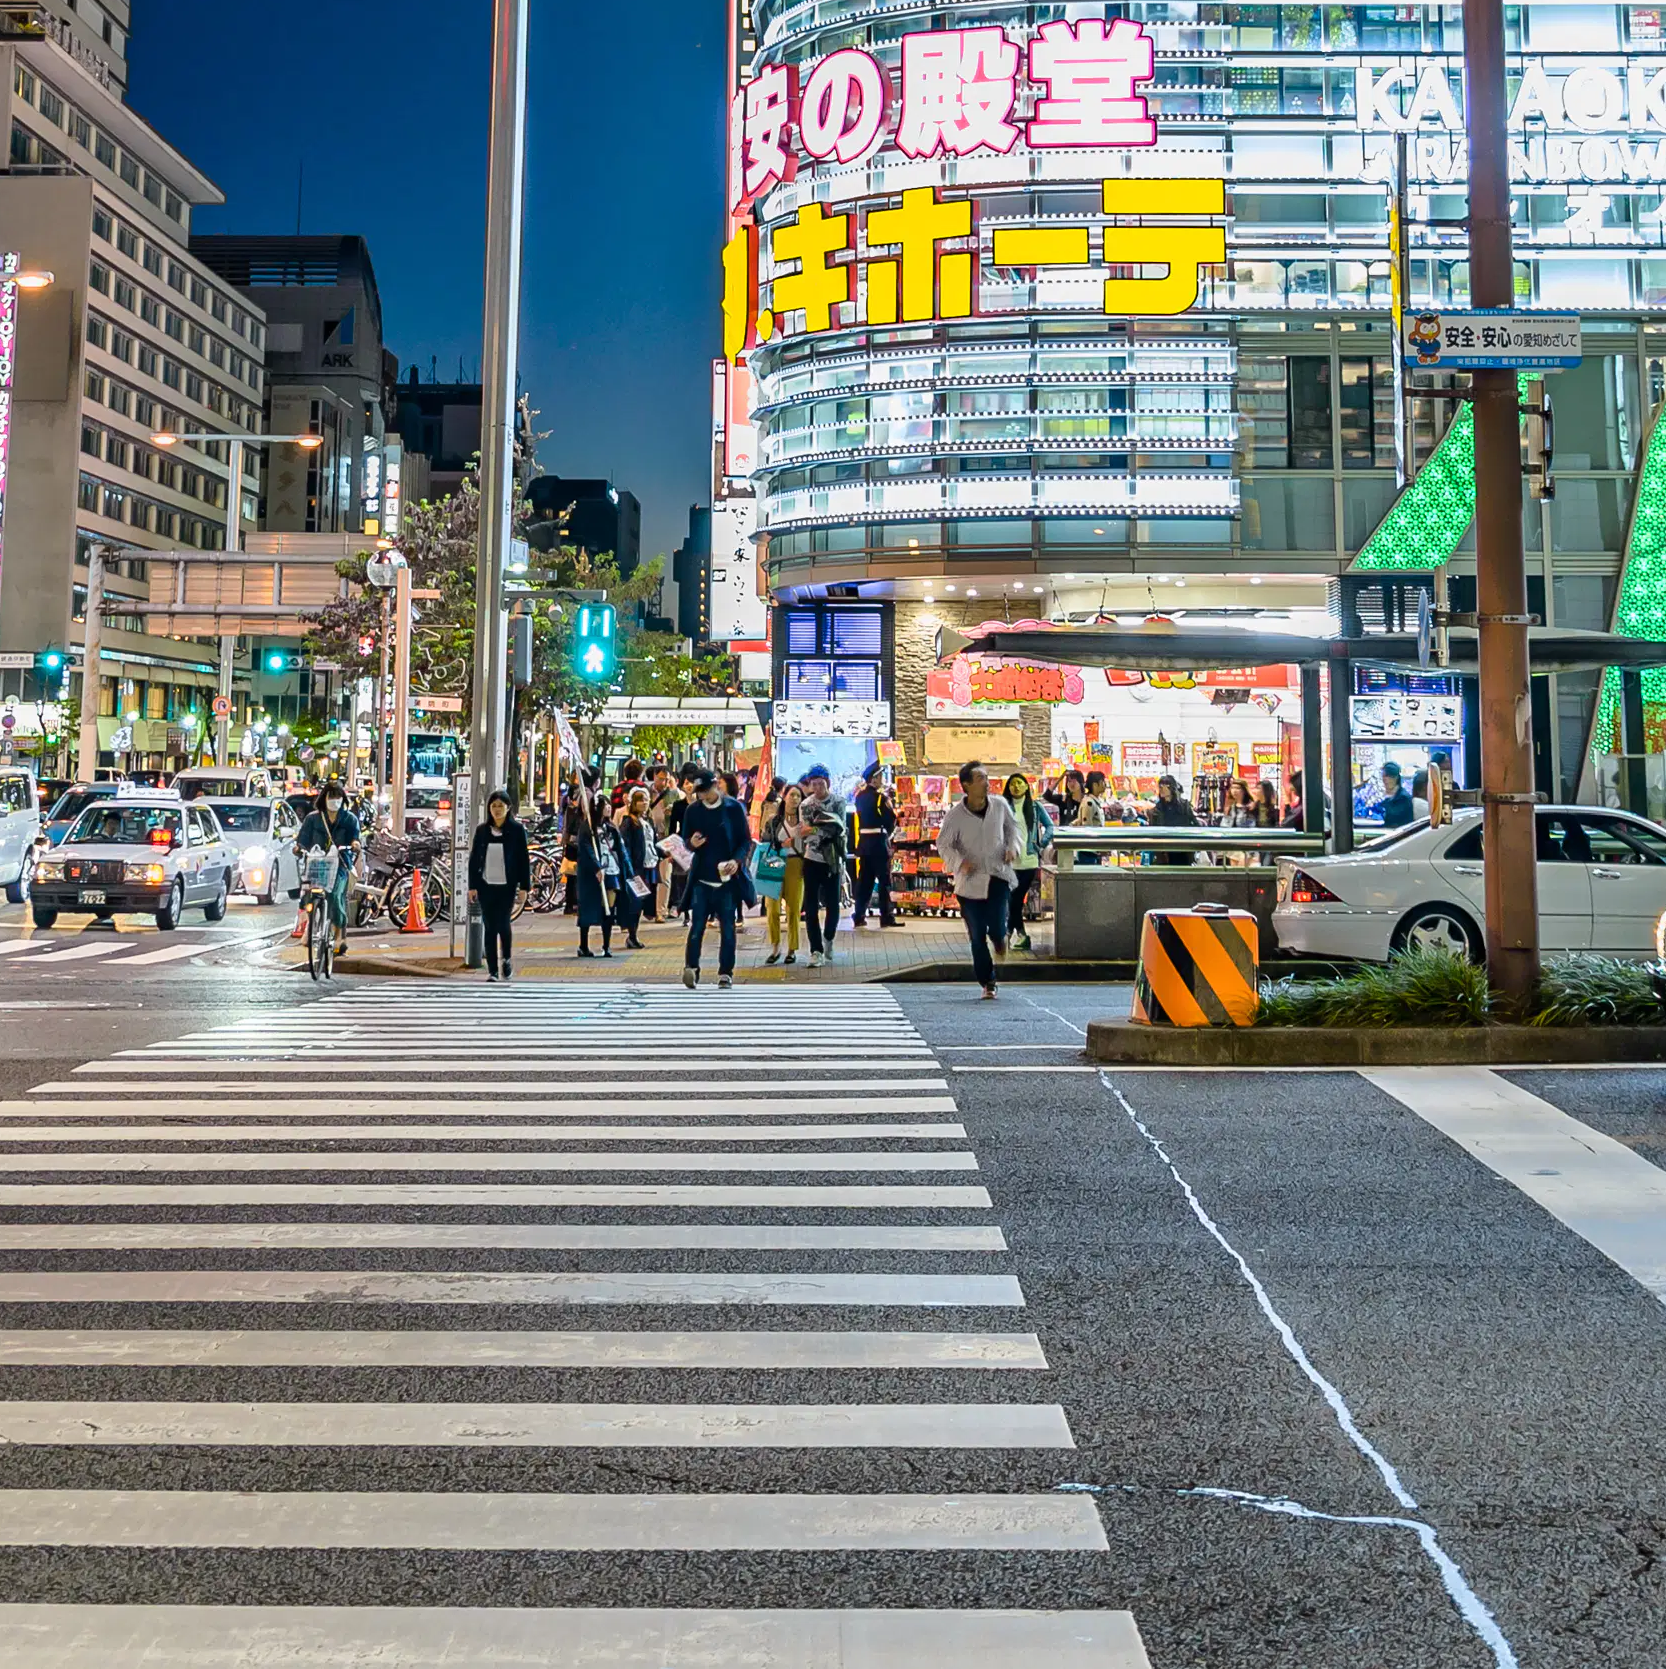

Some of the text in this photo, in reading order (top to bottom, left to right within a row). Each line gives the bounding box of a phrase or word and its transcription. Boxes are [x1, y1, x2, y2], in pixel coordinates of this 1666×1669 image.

[732, 17, 1158, 216] 安の殿堂
[1445, 325, 1578, 349] 安全・安心の愛知めざして
[321, 353, 355, 367] ARK
[83, 893, 106, 905] 76-22
